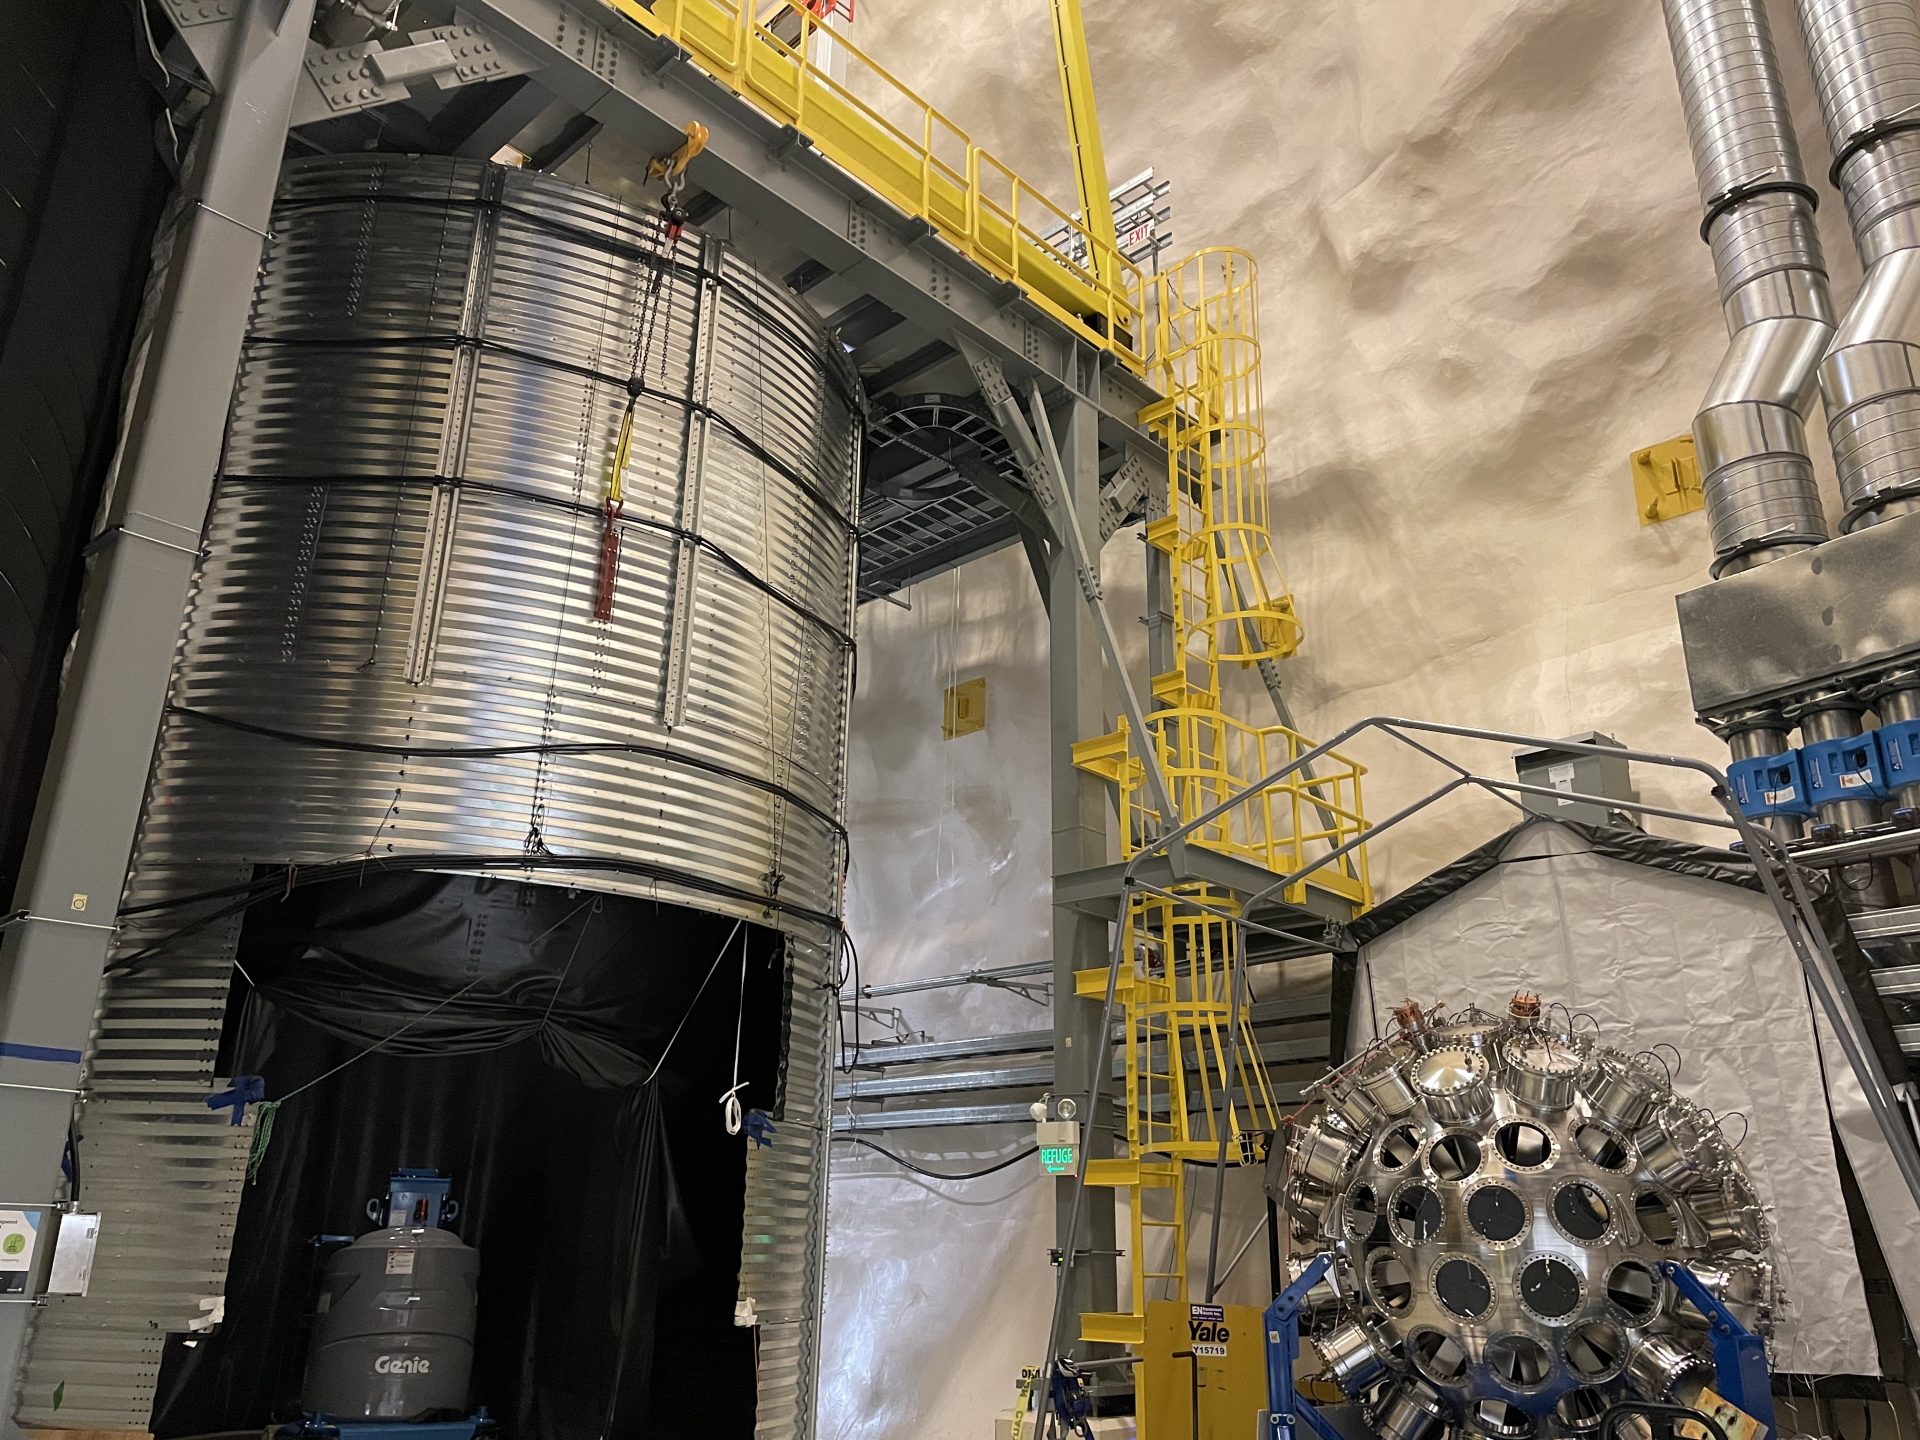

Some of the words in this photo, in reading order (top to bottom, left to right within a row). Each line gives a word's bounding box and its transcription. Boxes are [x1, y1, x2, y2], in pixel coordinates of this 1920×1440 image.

[1128, 223, 1149, 246] EXIT
[1041, 1148, 1073, 1164] REFUGE
[1188, 1320, 1230, 1343] Yale
[1193, 1346, 1225, 1355] Y15719
[375, 1355, 430, 1374] Genie
